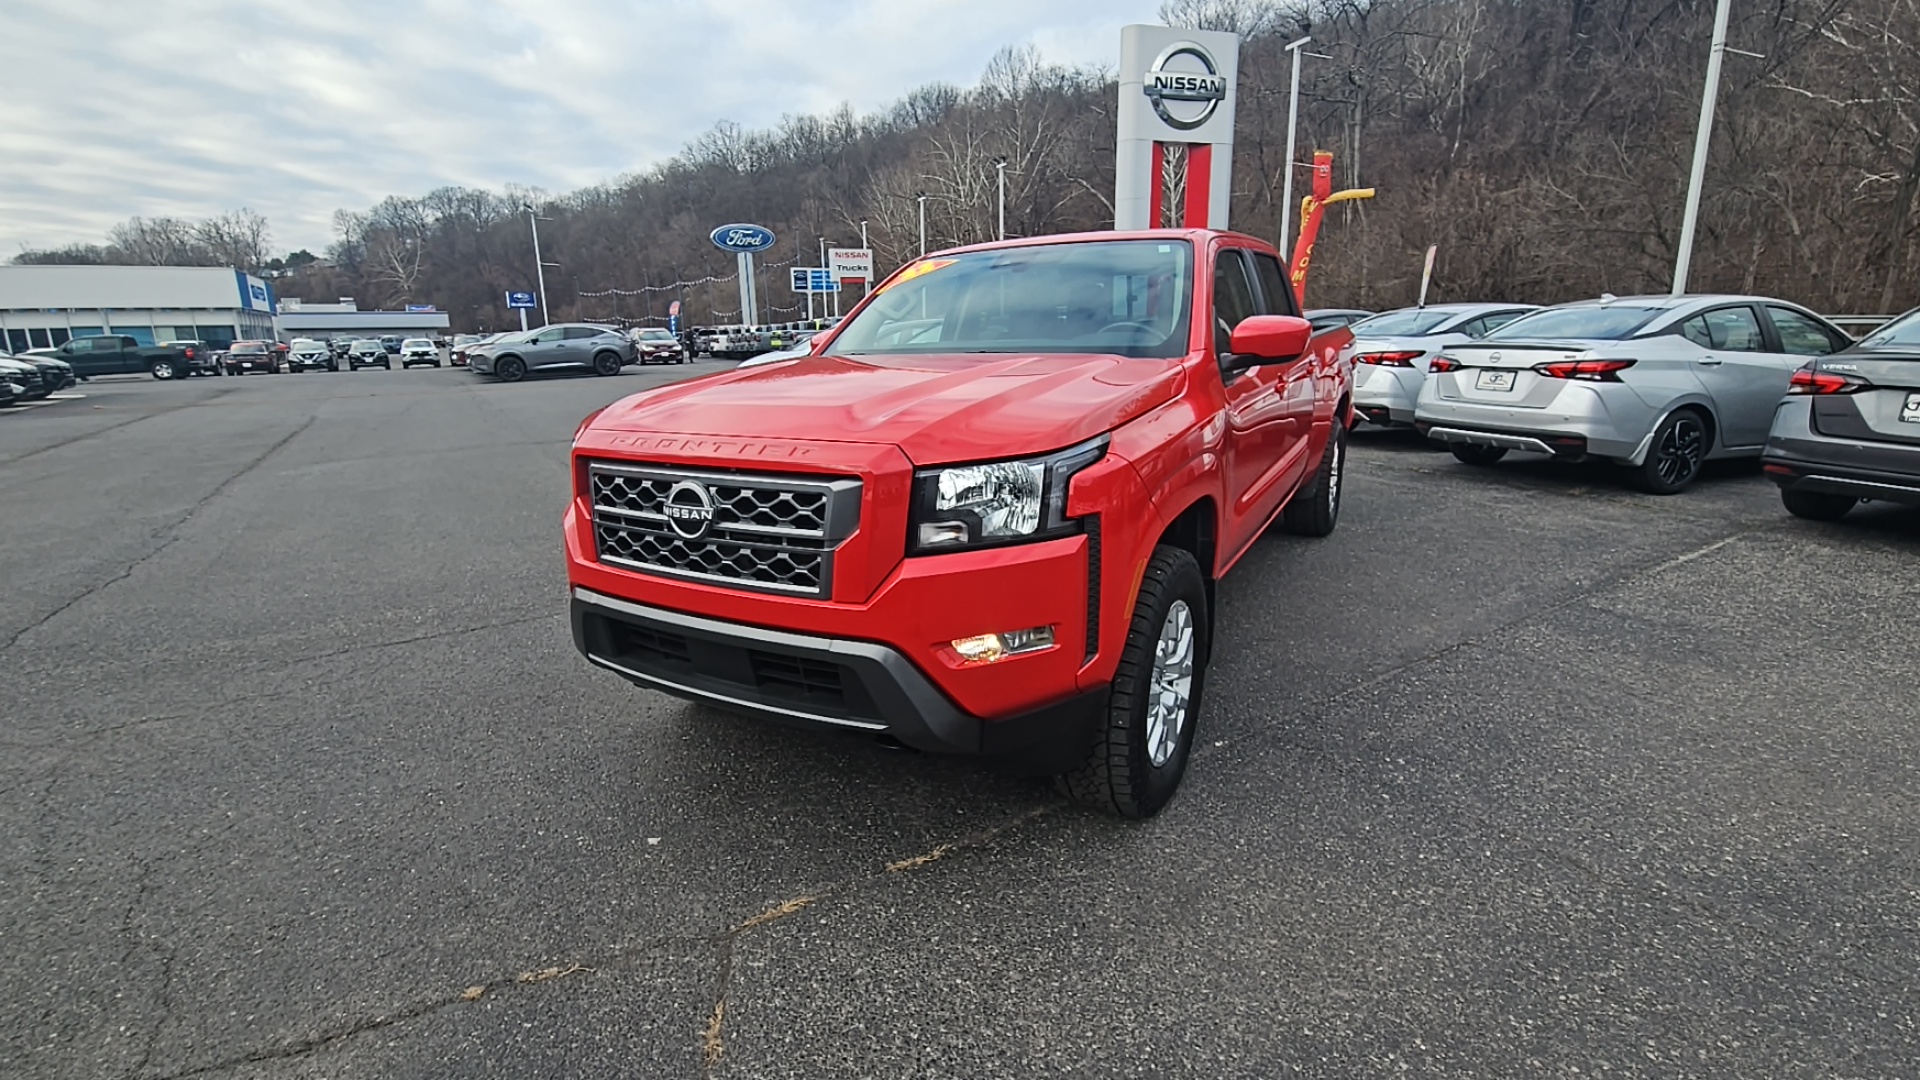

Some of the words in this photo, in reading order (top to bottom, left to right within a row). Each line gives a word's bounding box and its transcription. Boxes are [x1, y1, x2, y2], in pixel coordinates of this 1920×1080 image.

[1154, 76, 1221, 93] NISSAN
[726, 229, 763, 246] Ford
[835, 251, 869, 259] NISSAN
[836, 264, 868, 272] Trucks
[1822, 363, 1858, 371] VERSA
[609, 436, 819, 457] FRONTIER
[663, 505, 714, 520] NISSAN
